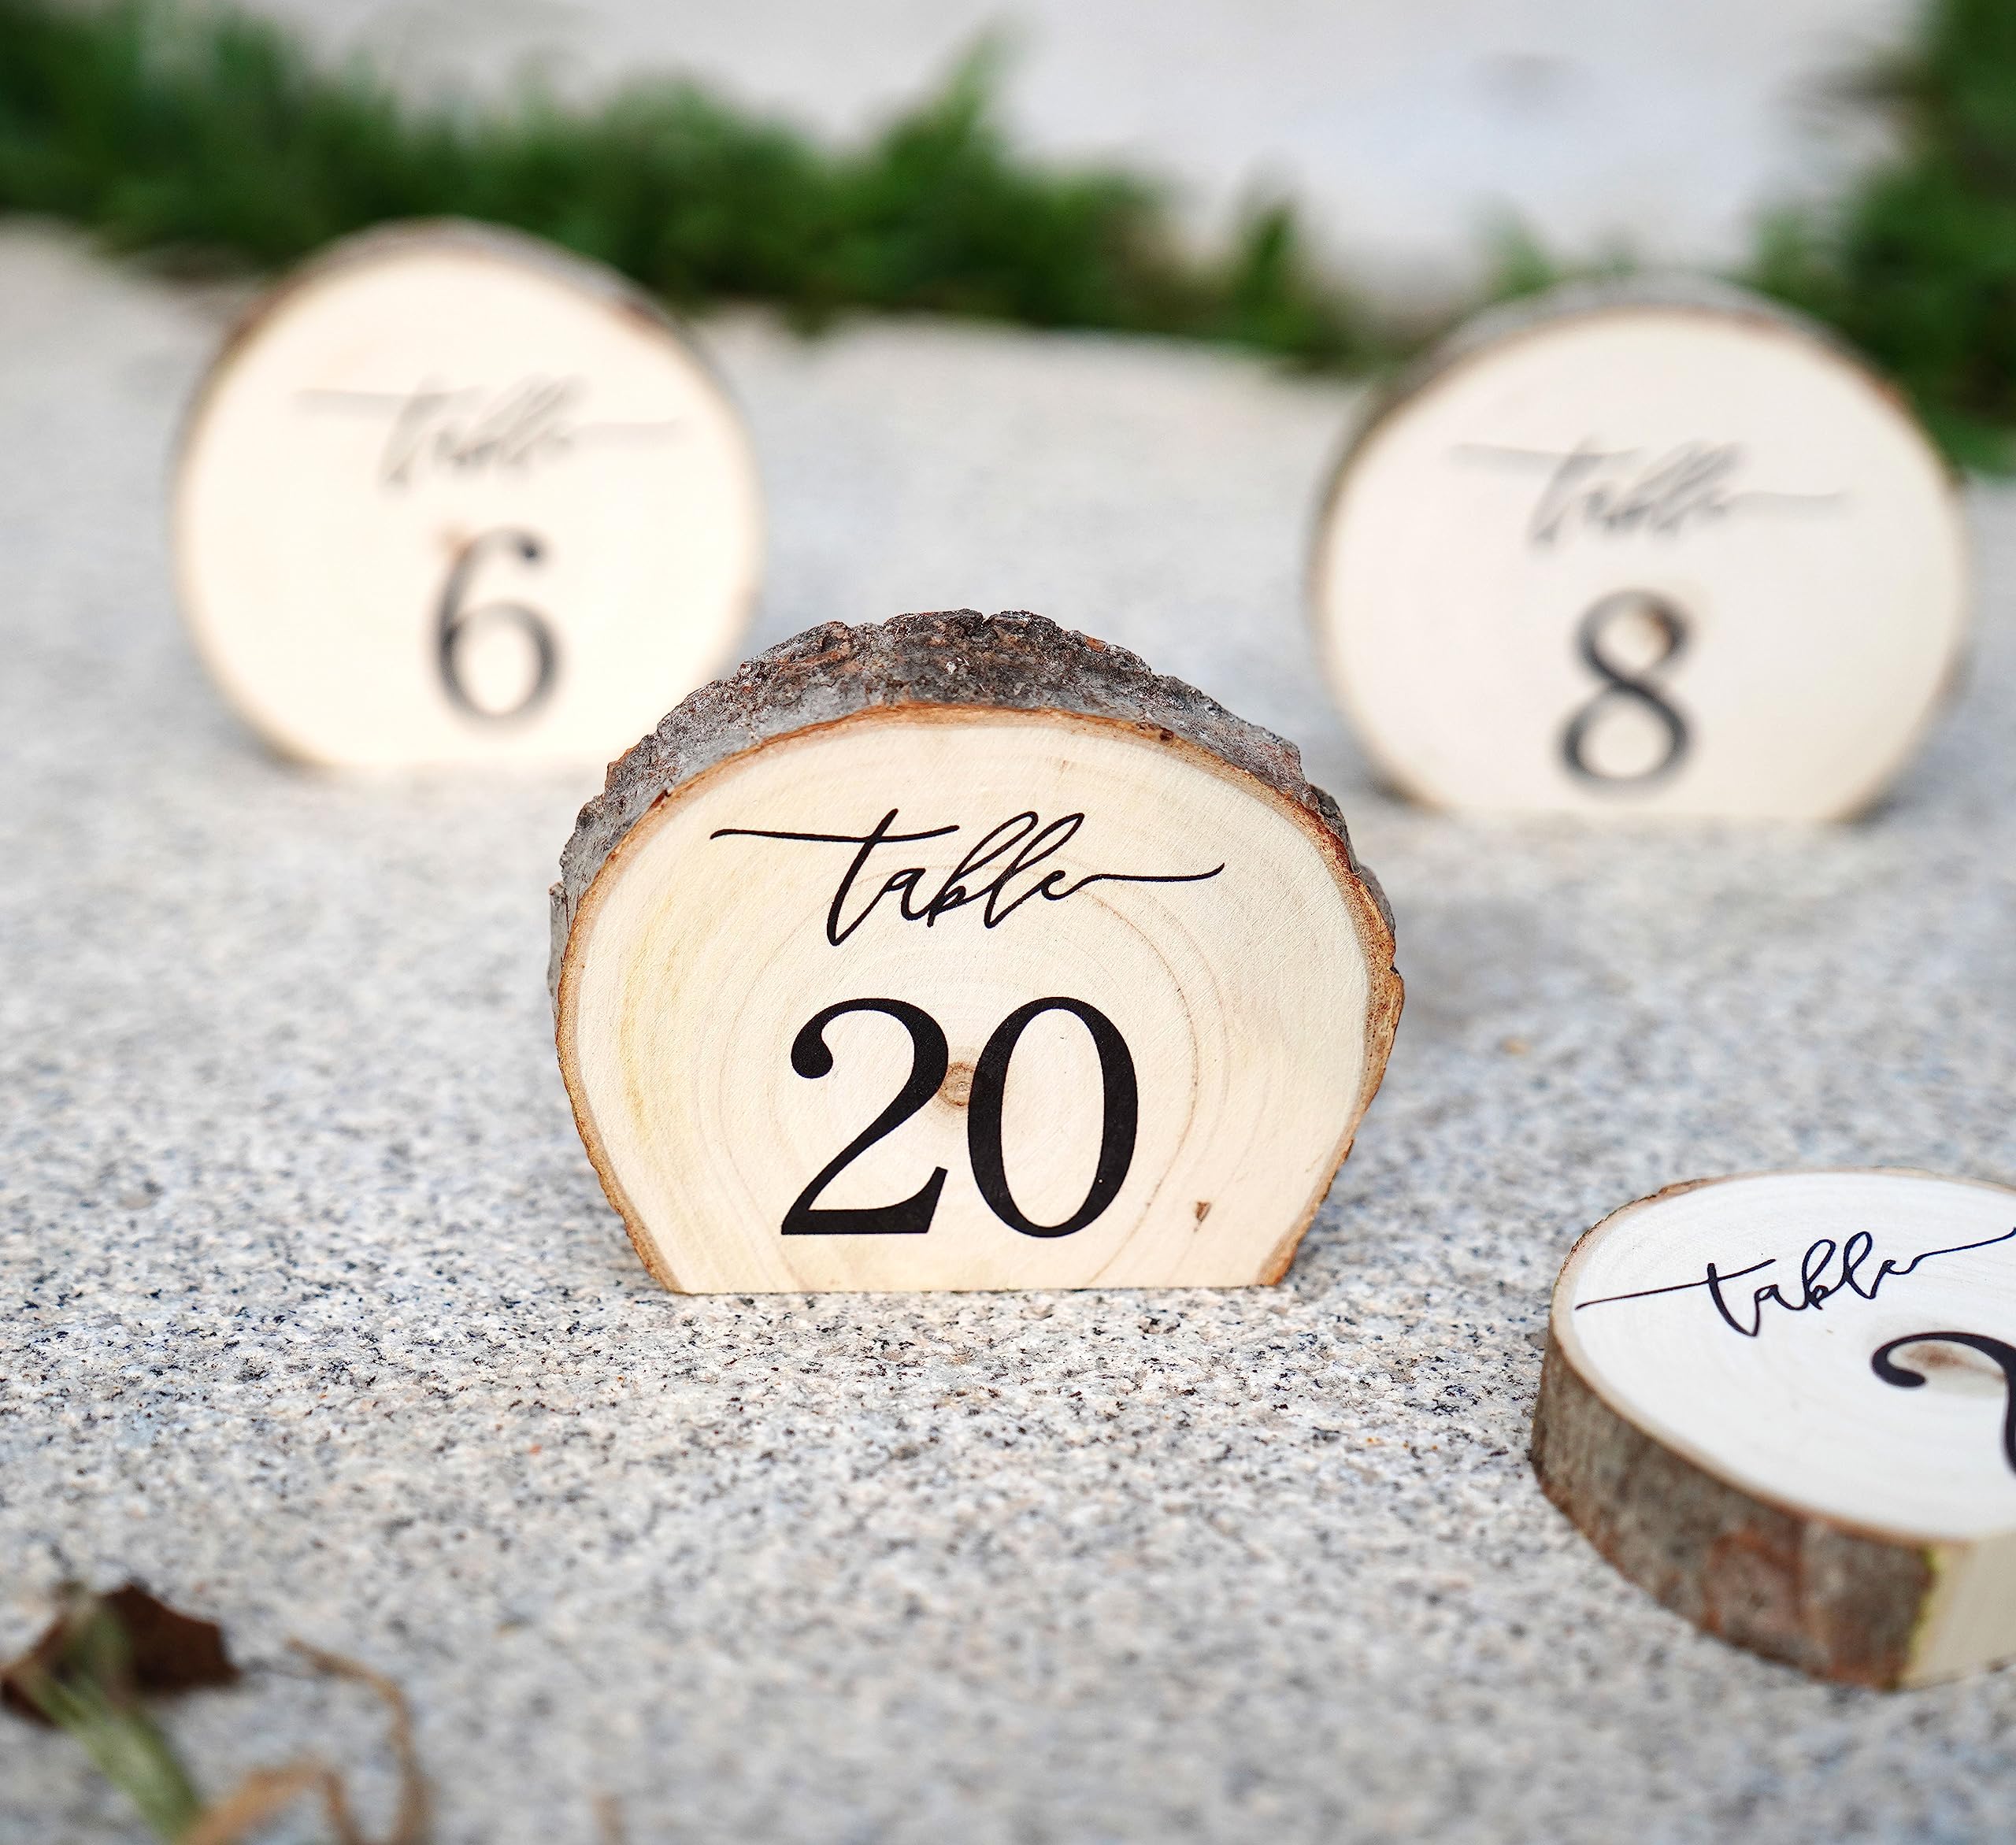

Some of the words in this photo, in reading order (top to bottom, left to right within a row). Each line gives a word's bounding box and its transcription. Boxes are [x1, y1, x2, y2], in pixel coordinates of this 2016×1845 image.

[430, 528, 562, 726] 6
[1558, 591, 1695, 791] 8
[710, 808, 1225, 947] table
[780, 996, 1139, 1239] 20
[1575, 1227, 2016, 1338] table
